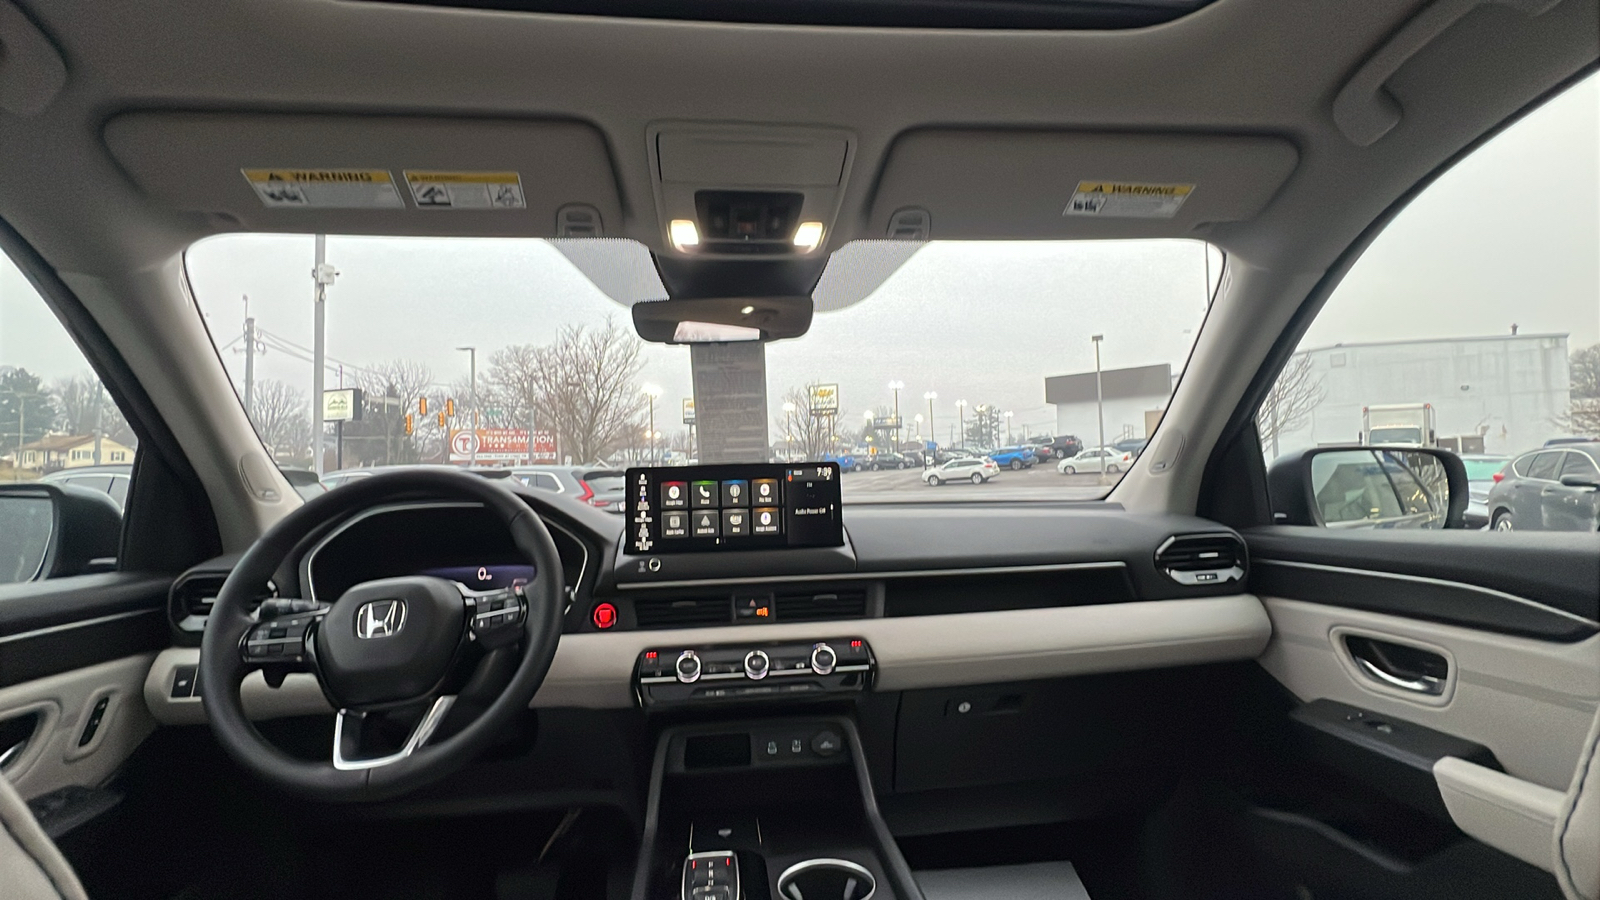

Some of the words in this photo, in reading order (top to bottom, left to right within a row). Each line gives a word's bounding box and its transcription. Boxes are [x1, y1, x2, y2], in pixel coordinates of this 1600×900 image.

[293, 171, 372, 183] WARNING
[1112, 184, 1176, 195] WARNING
[478, 567, 486, 580] 0
